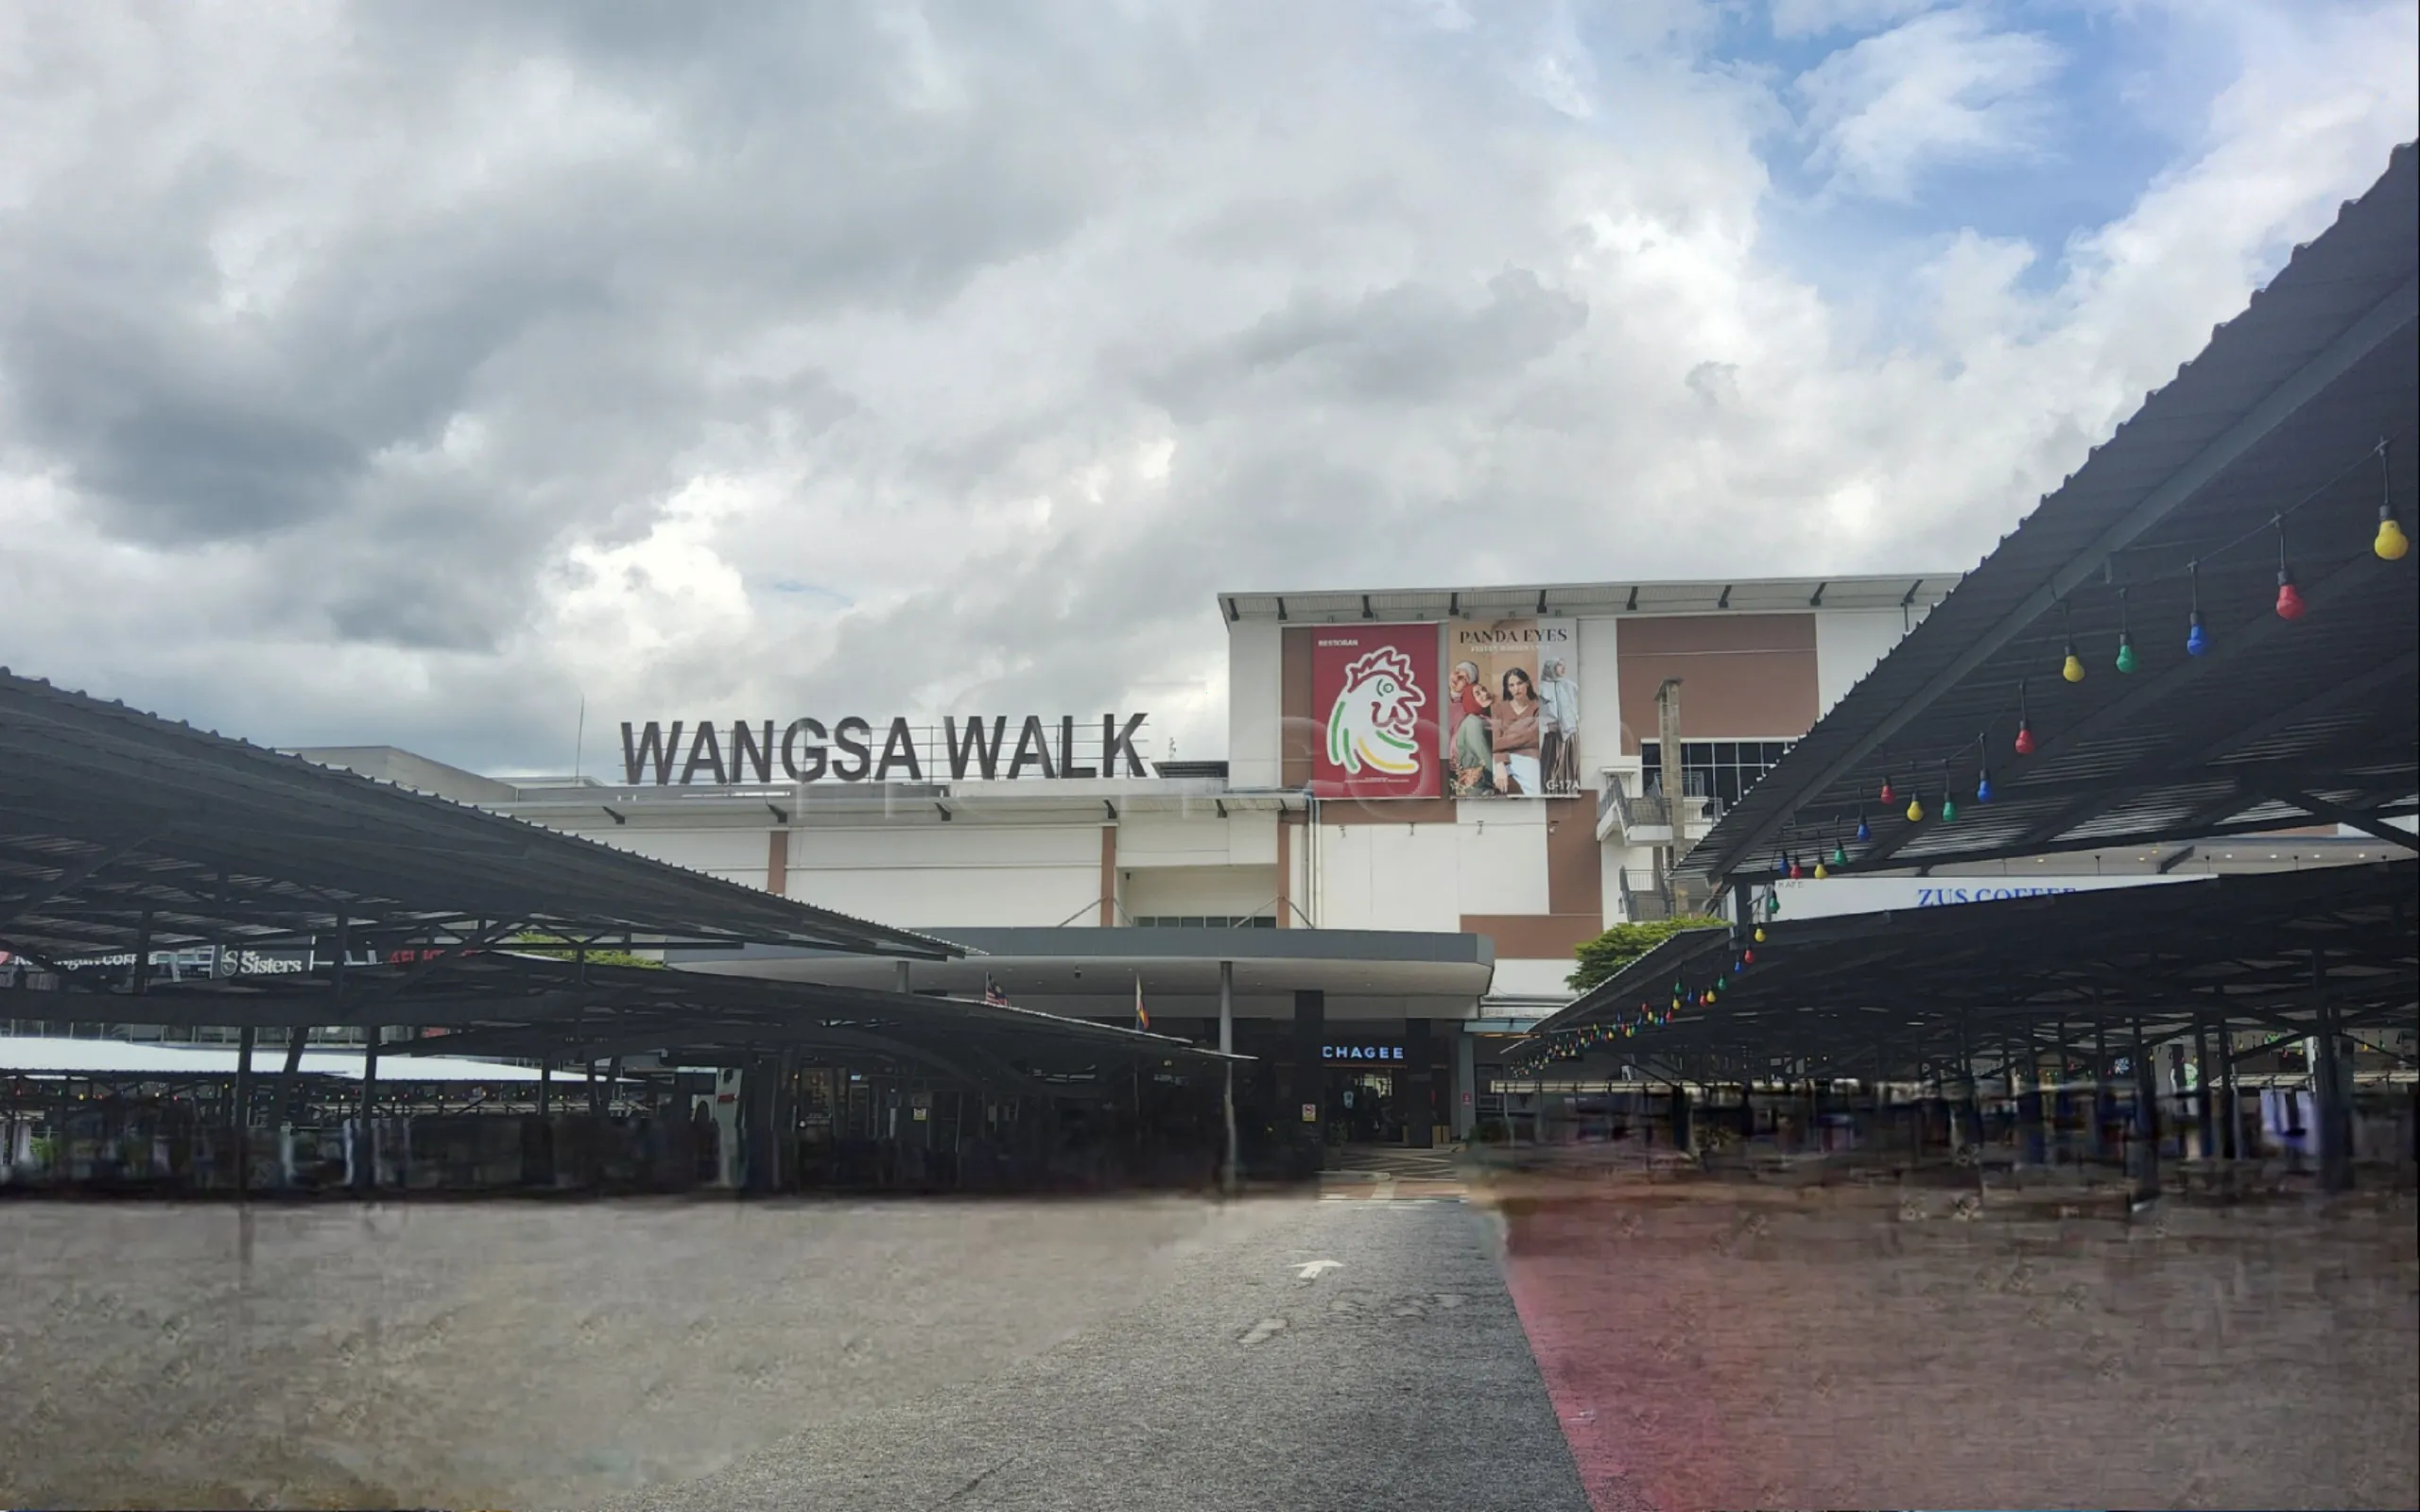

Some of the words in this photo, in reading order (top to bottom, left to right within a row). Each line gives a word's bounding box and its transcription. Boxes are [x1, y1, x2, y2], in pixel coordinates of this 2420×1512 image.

[1460, 629, 1518, 644] PANDA
[1524, 628, 1567, 643] EYES
[620, 715, 923, 785] WANGSA
[943, 713, 1150, 781] WALK
[1918, 888, 1968, 906] ZUS
[102, 954, 158, 966] COFFE
[240, 954, 302, 974] Sisters
[1322, 1046, 1404, 1059] CHAGEE
